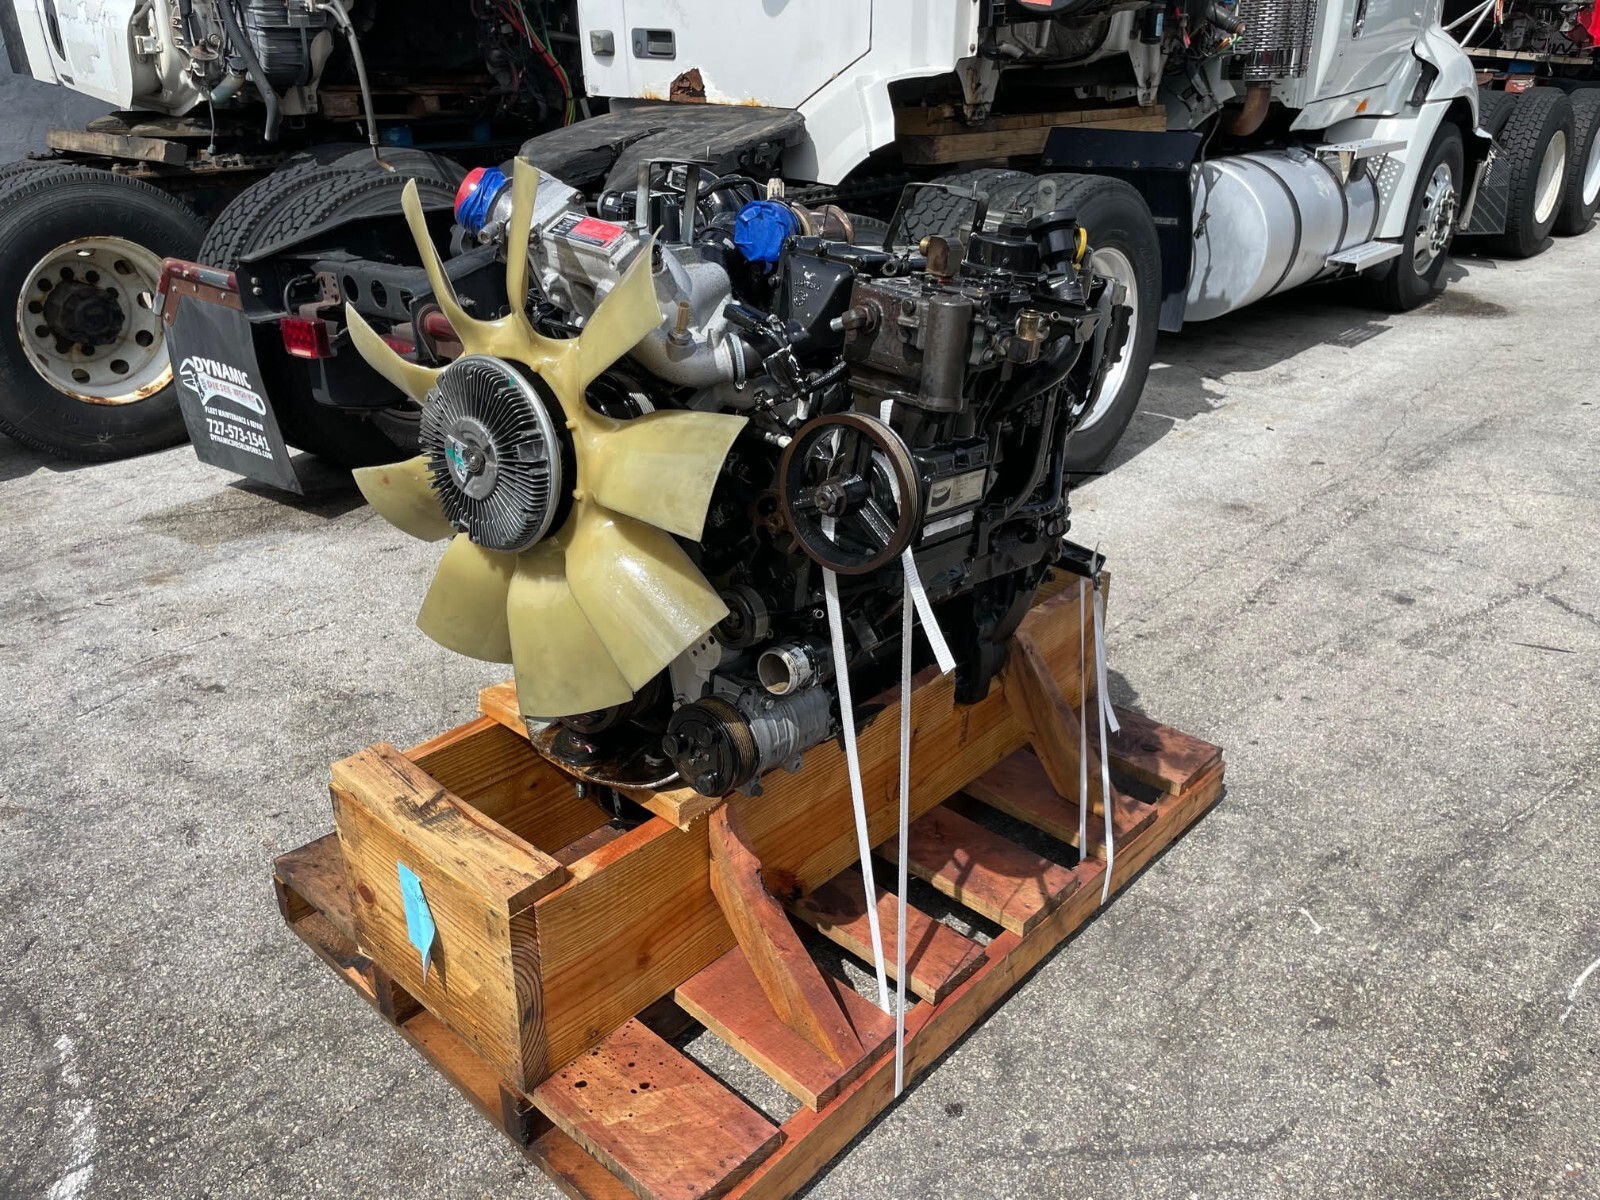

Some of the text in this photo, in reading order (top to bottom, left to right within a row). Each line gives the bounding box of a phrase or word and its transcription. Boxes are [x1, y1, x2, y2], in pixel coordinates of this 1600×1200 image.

[192, 356, 252, 389] DYNAMIC
[207, 380, 231, 394] DIESEL
[204, 406, 218, 416] FLEET
[206, 418, 271, 452] 727-573-1541
